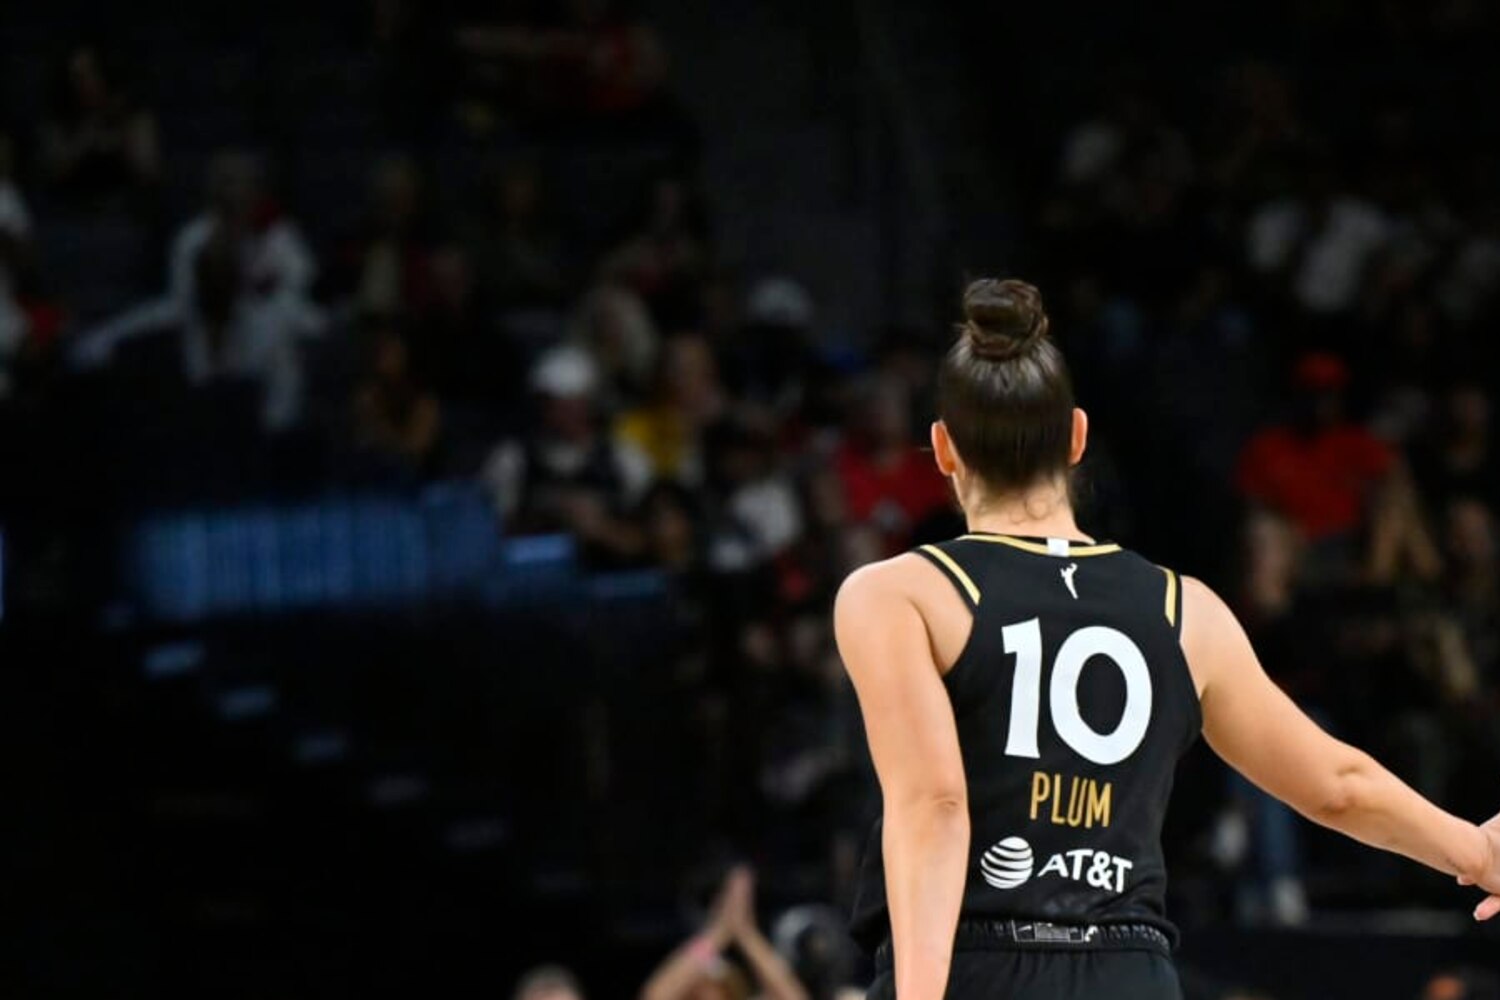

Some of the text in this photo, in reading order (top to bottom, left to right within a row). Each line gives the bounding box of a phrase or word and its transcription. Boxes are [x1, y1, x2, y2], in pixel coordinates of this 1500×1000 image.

[1002, 618, 1152, 765] 10
[1029, 771, 1112, 829] PLUM
[1037, 849, 1133, 893] AT&T
